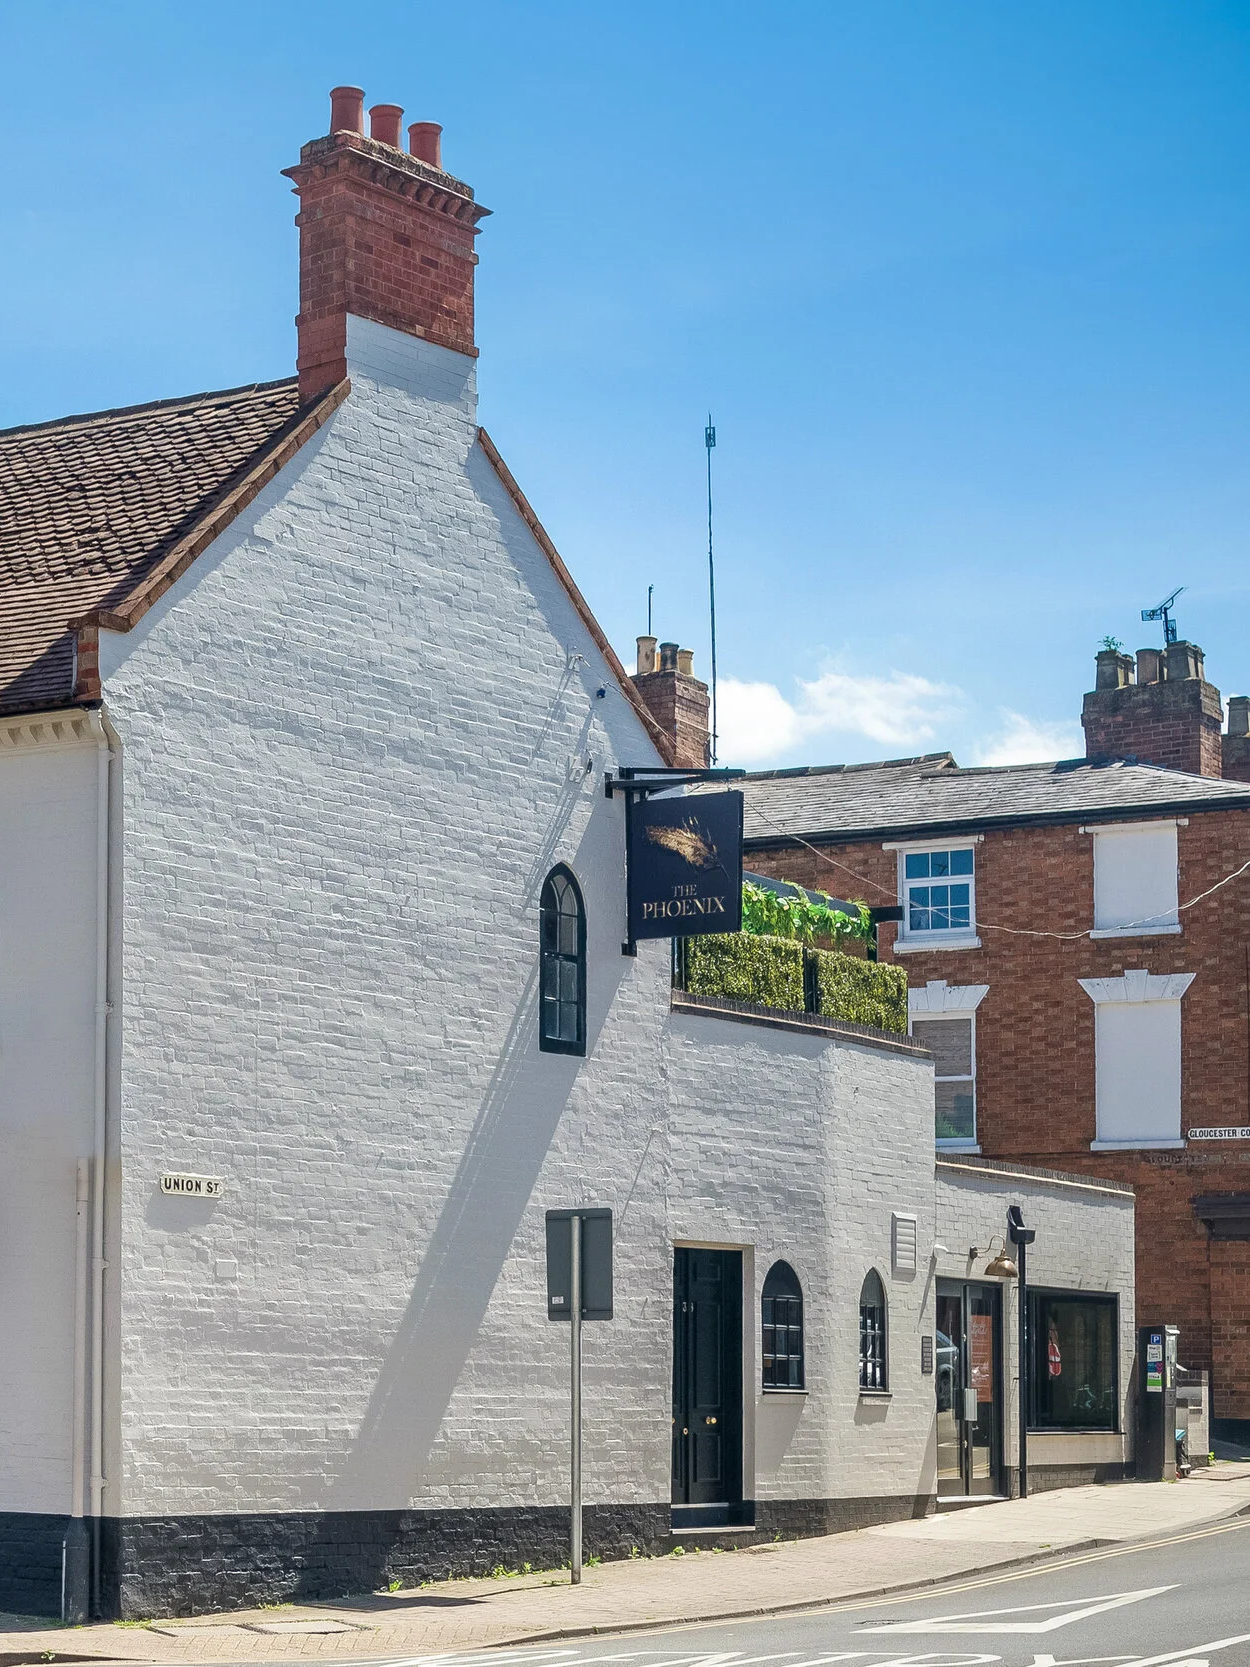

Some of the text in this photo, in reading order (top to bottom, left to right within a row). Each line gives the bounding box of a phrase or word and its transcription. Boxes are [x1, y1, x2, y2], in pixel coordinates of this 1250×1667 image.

[671, 884, 697, 897] THE
[642, 896, 726, 919] PHOENIX
[1189, 1129, 1237, 1138] GLOUCESTER
[164, 1177, 202, 1192] UNION
